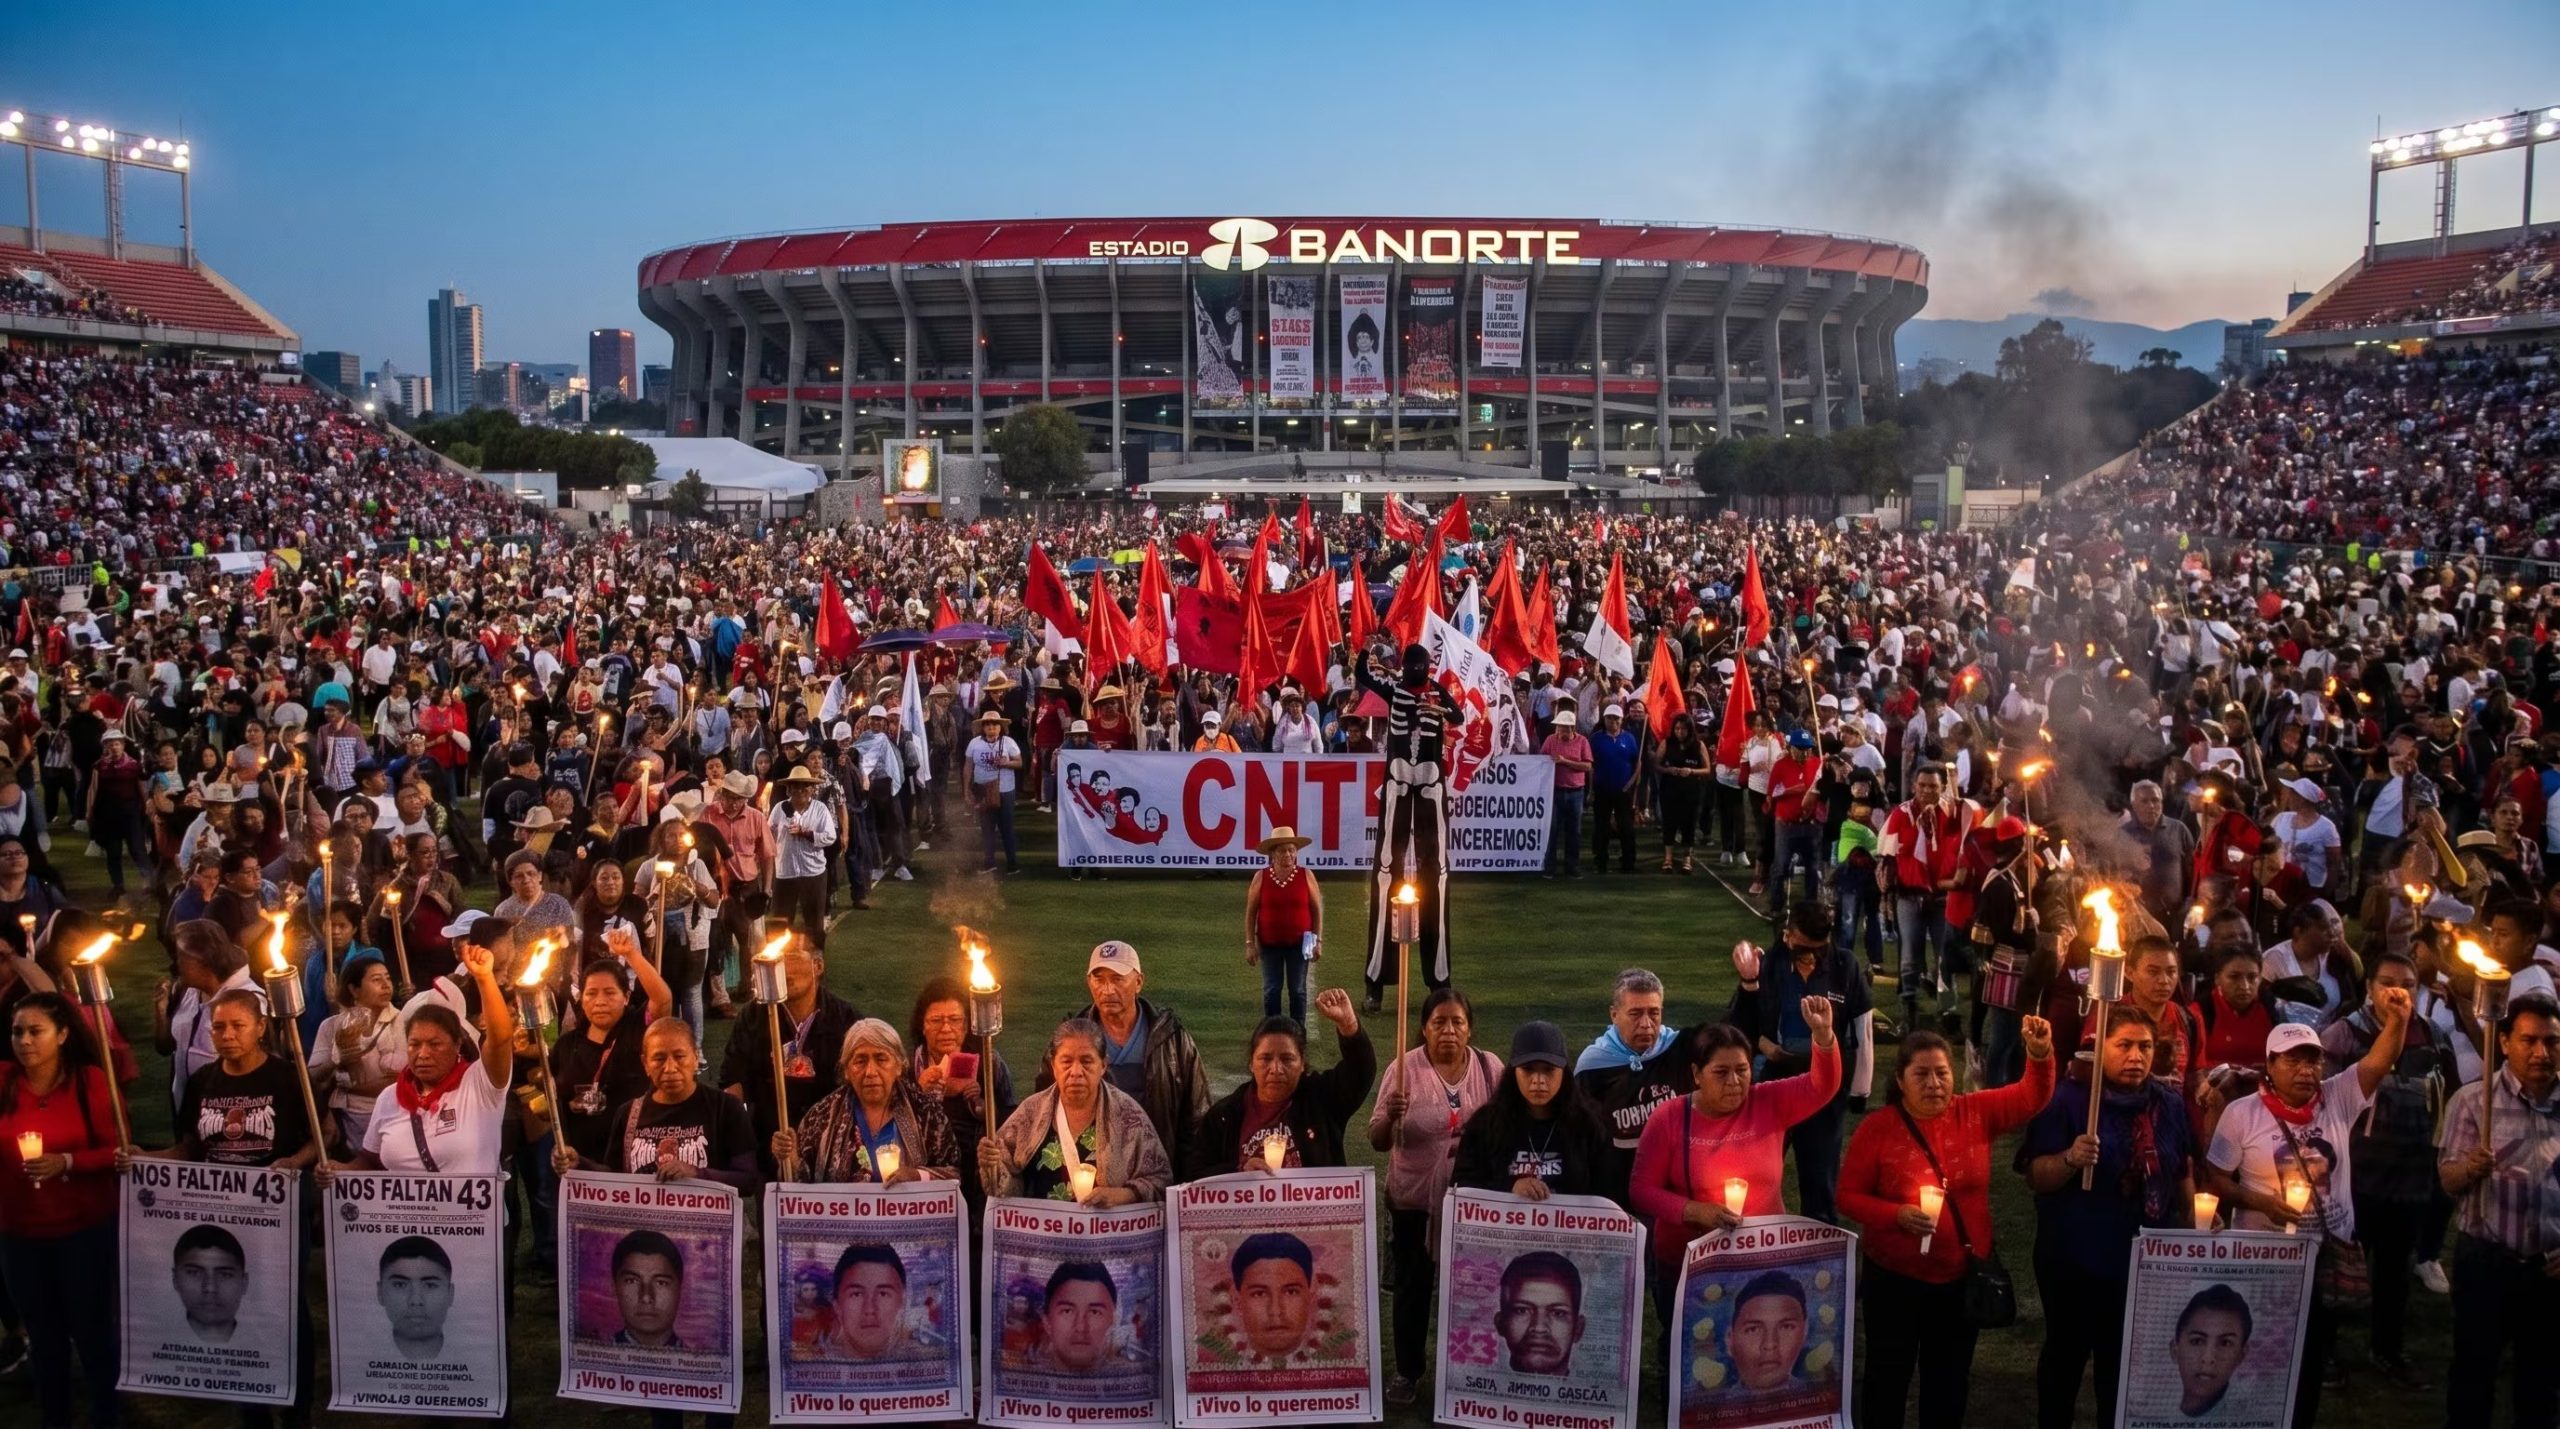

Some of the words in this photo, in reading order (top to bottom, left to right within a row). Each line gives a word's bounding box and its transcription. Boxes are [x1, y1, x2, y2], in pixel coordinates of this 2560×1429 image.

[1089, 240, 1189, 256] ESTADIO
[1290, 229, 1580, 265] BANORTE
[1447, 828, 1541, 850] NCEREMOS!
[132, 1164, 170, 1187] NOS
[177, 1166, 247, 1194] FALTAN
[252, 1173, 286, 1204] 43
[335, 1178, 375, 1201] NOS
[381, 1179, 452, 1203] FALTAN
[457, 1179, 492, 1211] 43
[567, 1182, 607, 1202] ¡Vivo
[611, 1189, 630, 1203] se
[635, 1187, 650, 1205] lo
[656, 1187, 730, 1210] llevaron!
[1182, 1186, 1229, 1208] ¡Vivo
[1234, 1190, 1254, 1203] se
[1259, 1185, 1276, 1202] lo
[1282, 1180, 1360, 1202] llevaron!
[780, 1197, 825, 1217] ¡Vivo
[829, 1201, 849, 1216] se
[854, 1199, 871, 1216] lo
[876, 1195, 954, 1217] llevaron!
[1457, 1202, 1500, 1223] ¡Vivo
[1505, 1211, 1526, 1225] se
[1531, 1208, 1548, 1227] lo
[1554, 1209, 1633, 1233] llevaron!
[996, 1209, 1039, 1230] ¡Vivo
[1044, 1218, 1063, 1234] se
[1068, 1216, 1084, 1235] lo
[1089, 1210, 1161, 1235] llevaron!
[1736, 1235, 1755, 1249] se
[1760, 1229, 1775, 1247] lo
[2187, 1244, 2206, 1258] se
[2211, 1240, 2227, 1258] lo
[2231, 1241, 2304, 1260] llevaron!
[185, 1377, 200, 1388] LO
[204, 1379, 277, 1394] QUEREMOS!
[575, 1370, 616, 1390] ¡Vivo
[620, 1375, 634, 1392] lo
[639, 1379, 723, 1399] queremos!
[415, 1395, 488, 1408] QUEREMOS!
[790, 1393, 834, 1413] ¡Vivo
[839, 1394, 854, 1411] lo
[859, 1390, 950, 1415] queremos!
[1000, 1398, 1042, 1417] ¡Vivo
[1046, 1401, 1062, 1418] lo
[1066, 1401, 1153, 1423] queremos!
[1196, 1396, 1241, 1417] ¡Vivo
[1246, 1395, 1262, 1412] lo
[1267, 1393, 1360, 1416] queremos!
[1454, 1399, 1498, 1419] ¡Vivo
[1502, 1405, 1518, 1422] lo
[1524, 1411, 1615, 1429] queremos!
